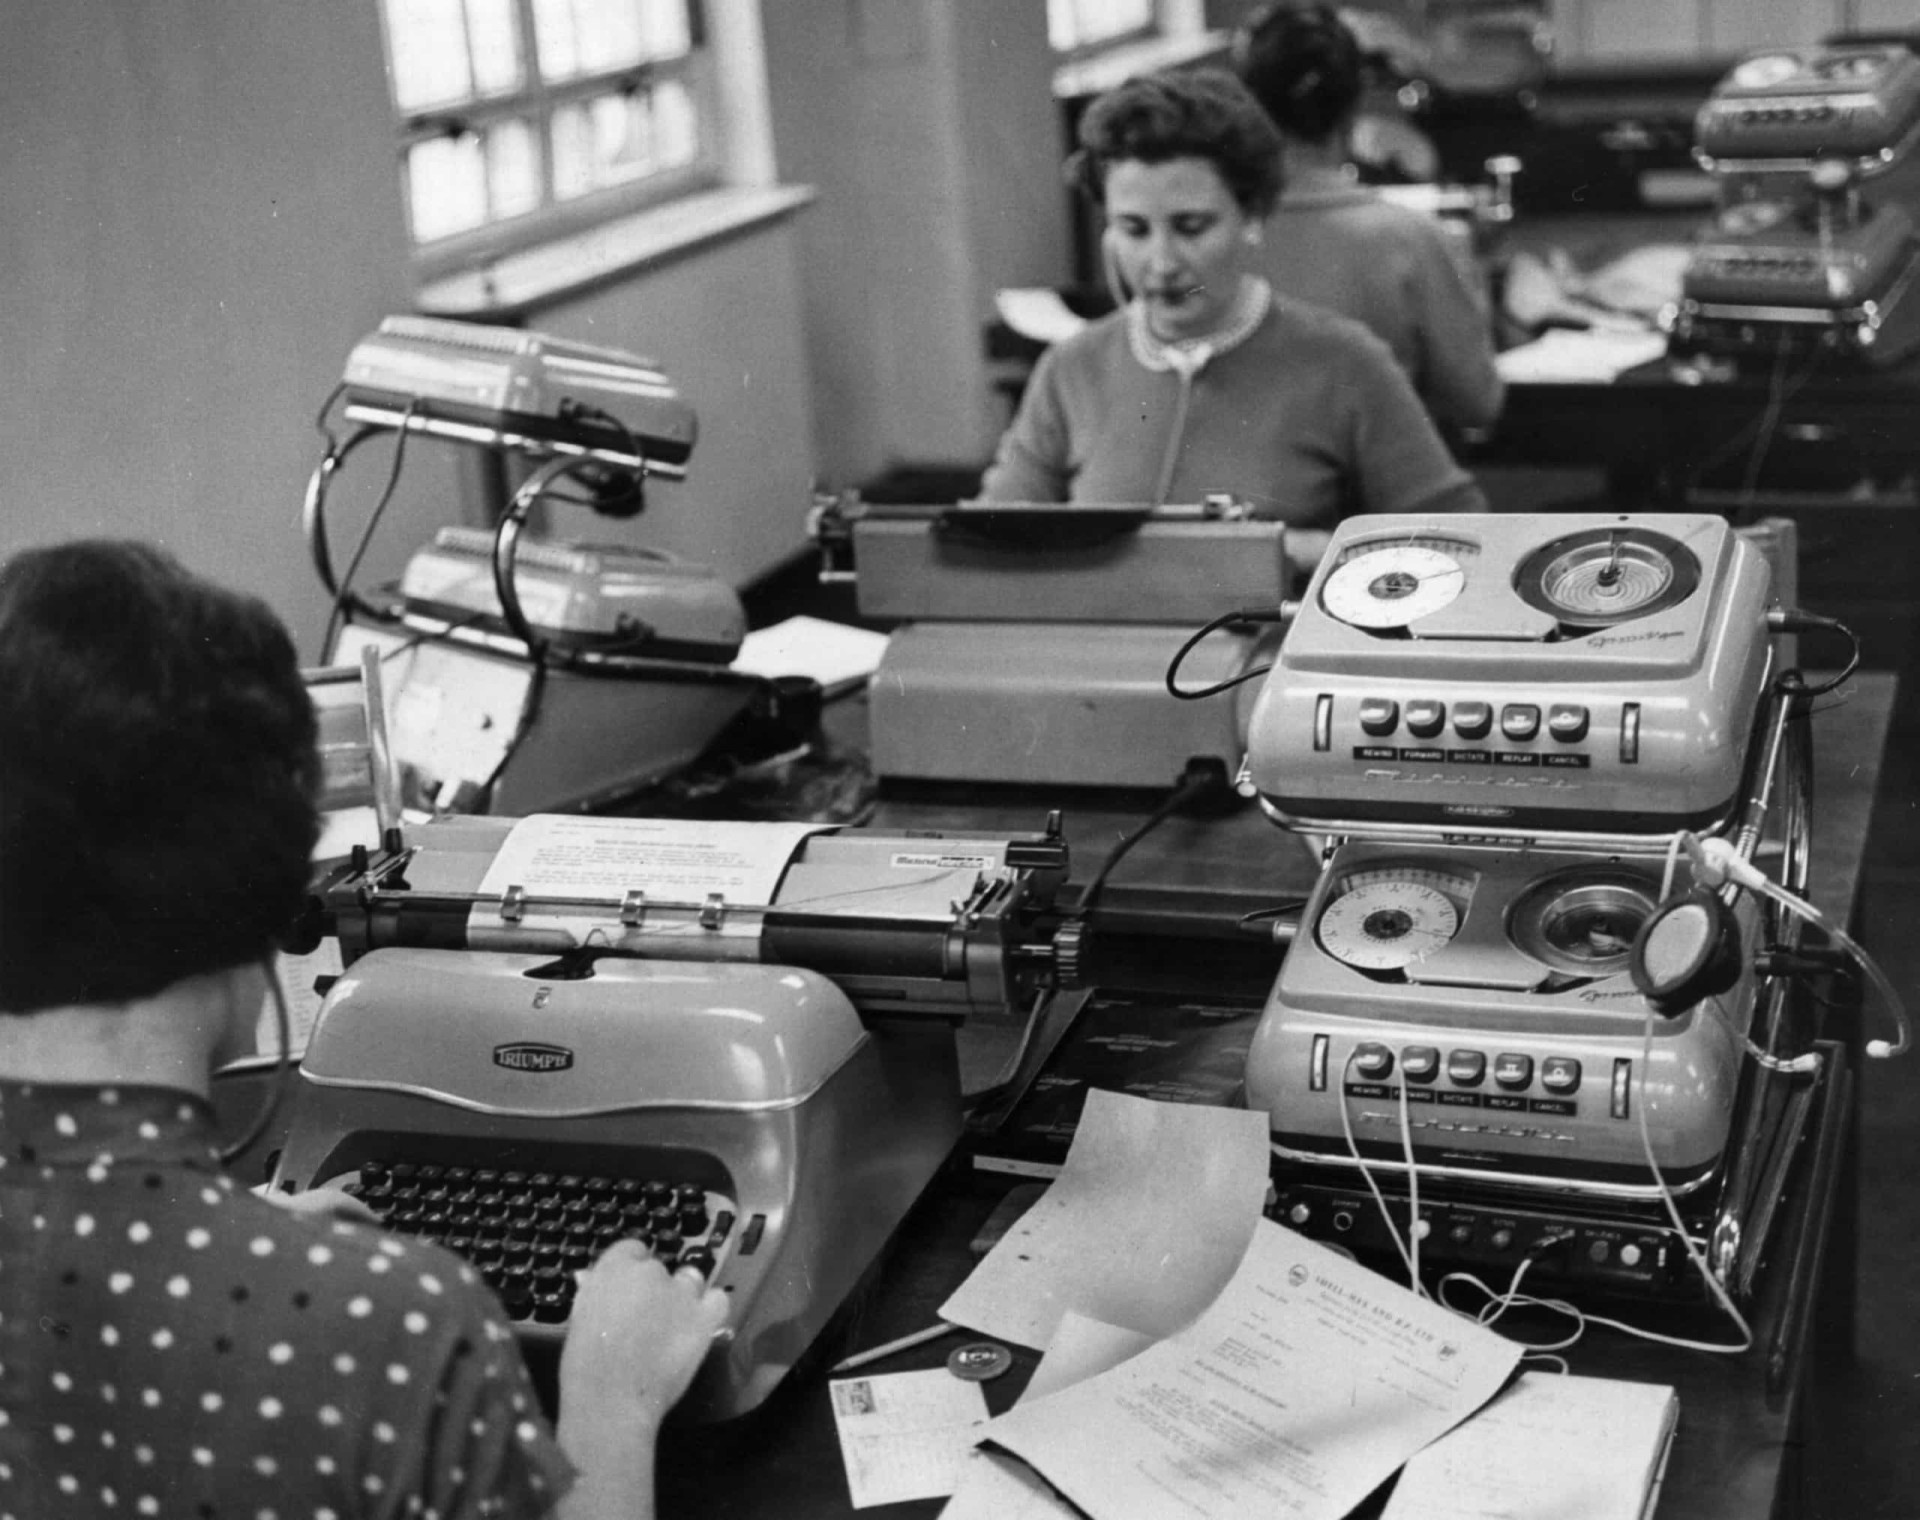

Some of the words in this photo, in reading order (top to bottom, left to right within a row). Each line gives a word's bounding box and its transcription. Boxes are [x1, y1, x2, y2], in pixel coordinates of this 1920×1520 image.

[1362, 748, 1394, 758] REWIND
[1403, 750, 1443, 760] FORWARD
[1453, 752, 1486, 762] DICTATE
[1502, 754, 1533, 763] REPLAY
[1548, 755, 1581, 766] CANCEL
[498, 1049, 568, 1069] TRIUMPH
